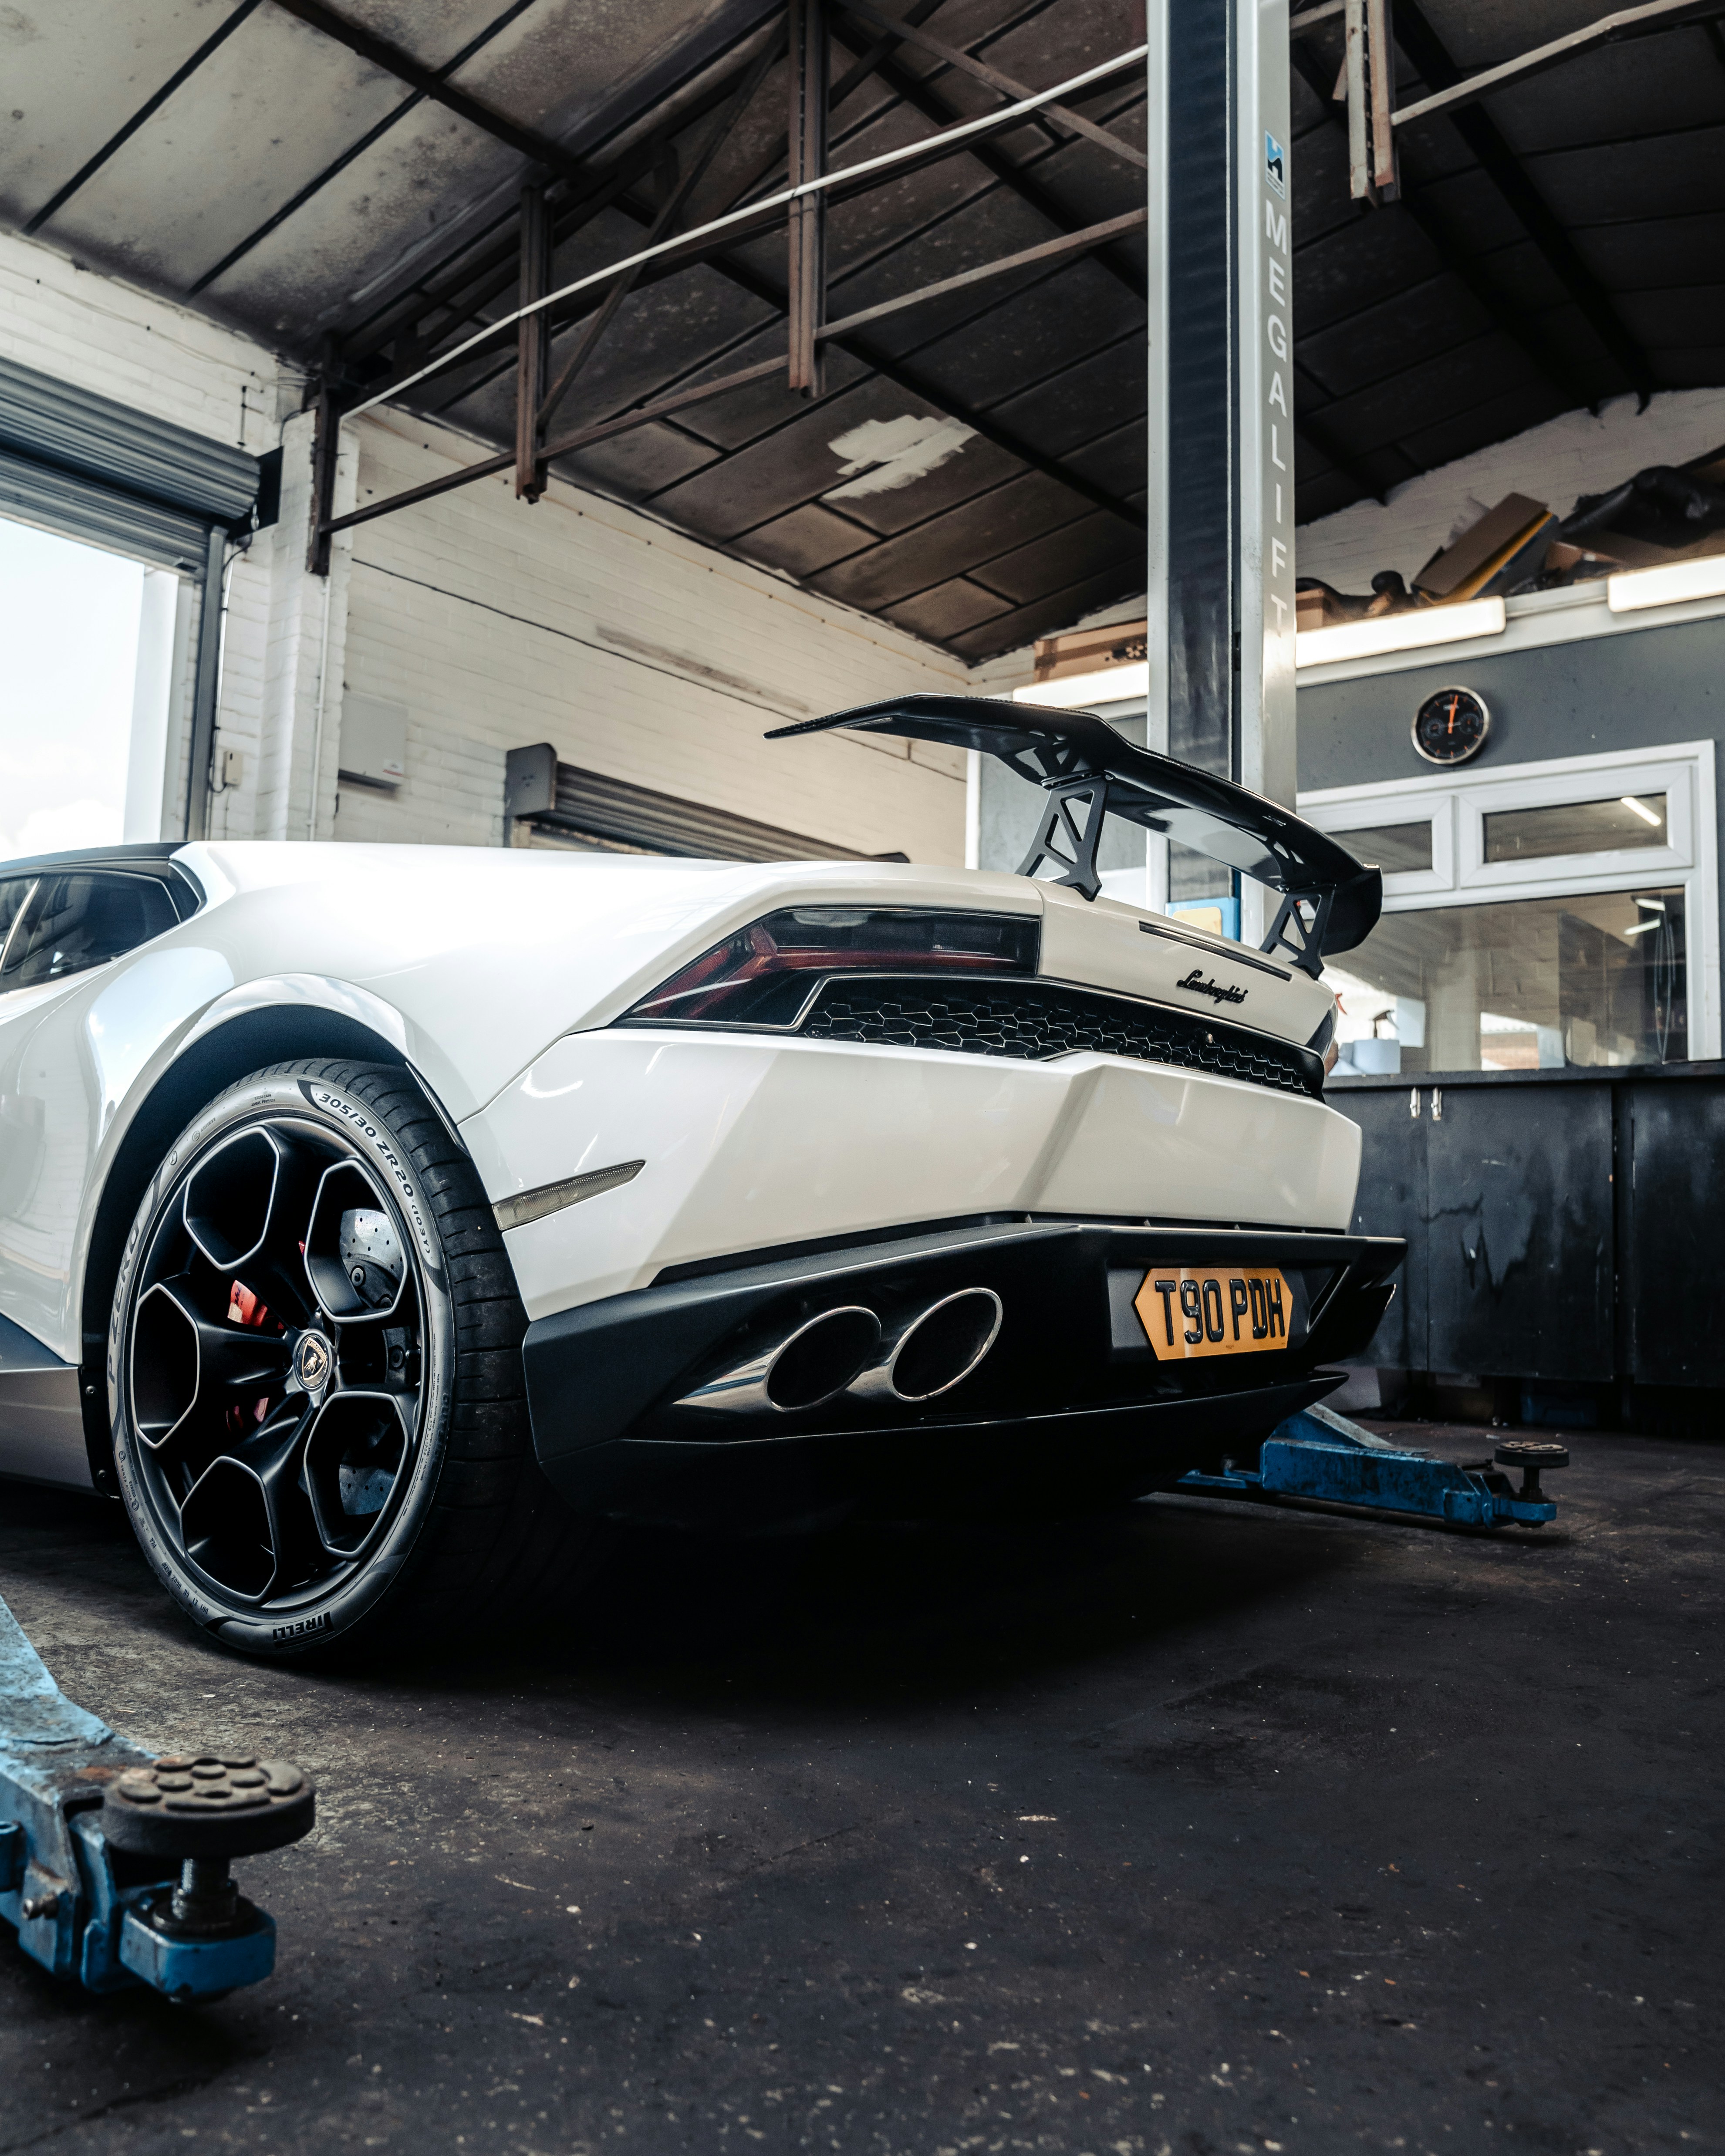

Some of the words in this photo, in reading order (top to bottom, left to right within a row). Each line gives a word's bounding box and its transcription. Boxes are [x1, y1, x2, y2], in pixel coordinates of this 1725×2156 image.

[1265, 198, 1288, 641] MEGALIFT
[1176, 969, 1249, 1004] Lamborghini
[318, 1093, 377, 1138] 305/30
[376, 1140, 414, 1198] ZR20
[411, 1204, 431, 1254] (103Y)
[112, 1220, 139, 1346] ZERO
[1154, 1279, 1225, 1346] T90
[1229, 1278, 1286, 1341] PDH
[272, 1611, 335, 1648] PIRELLI
